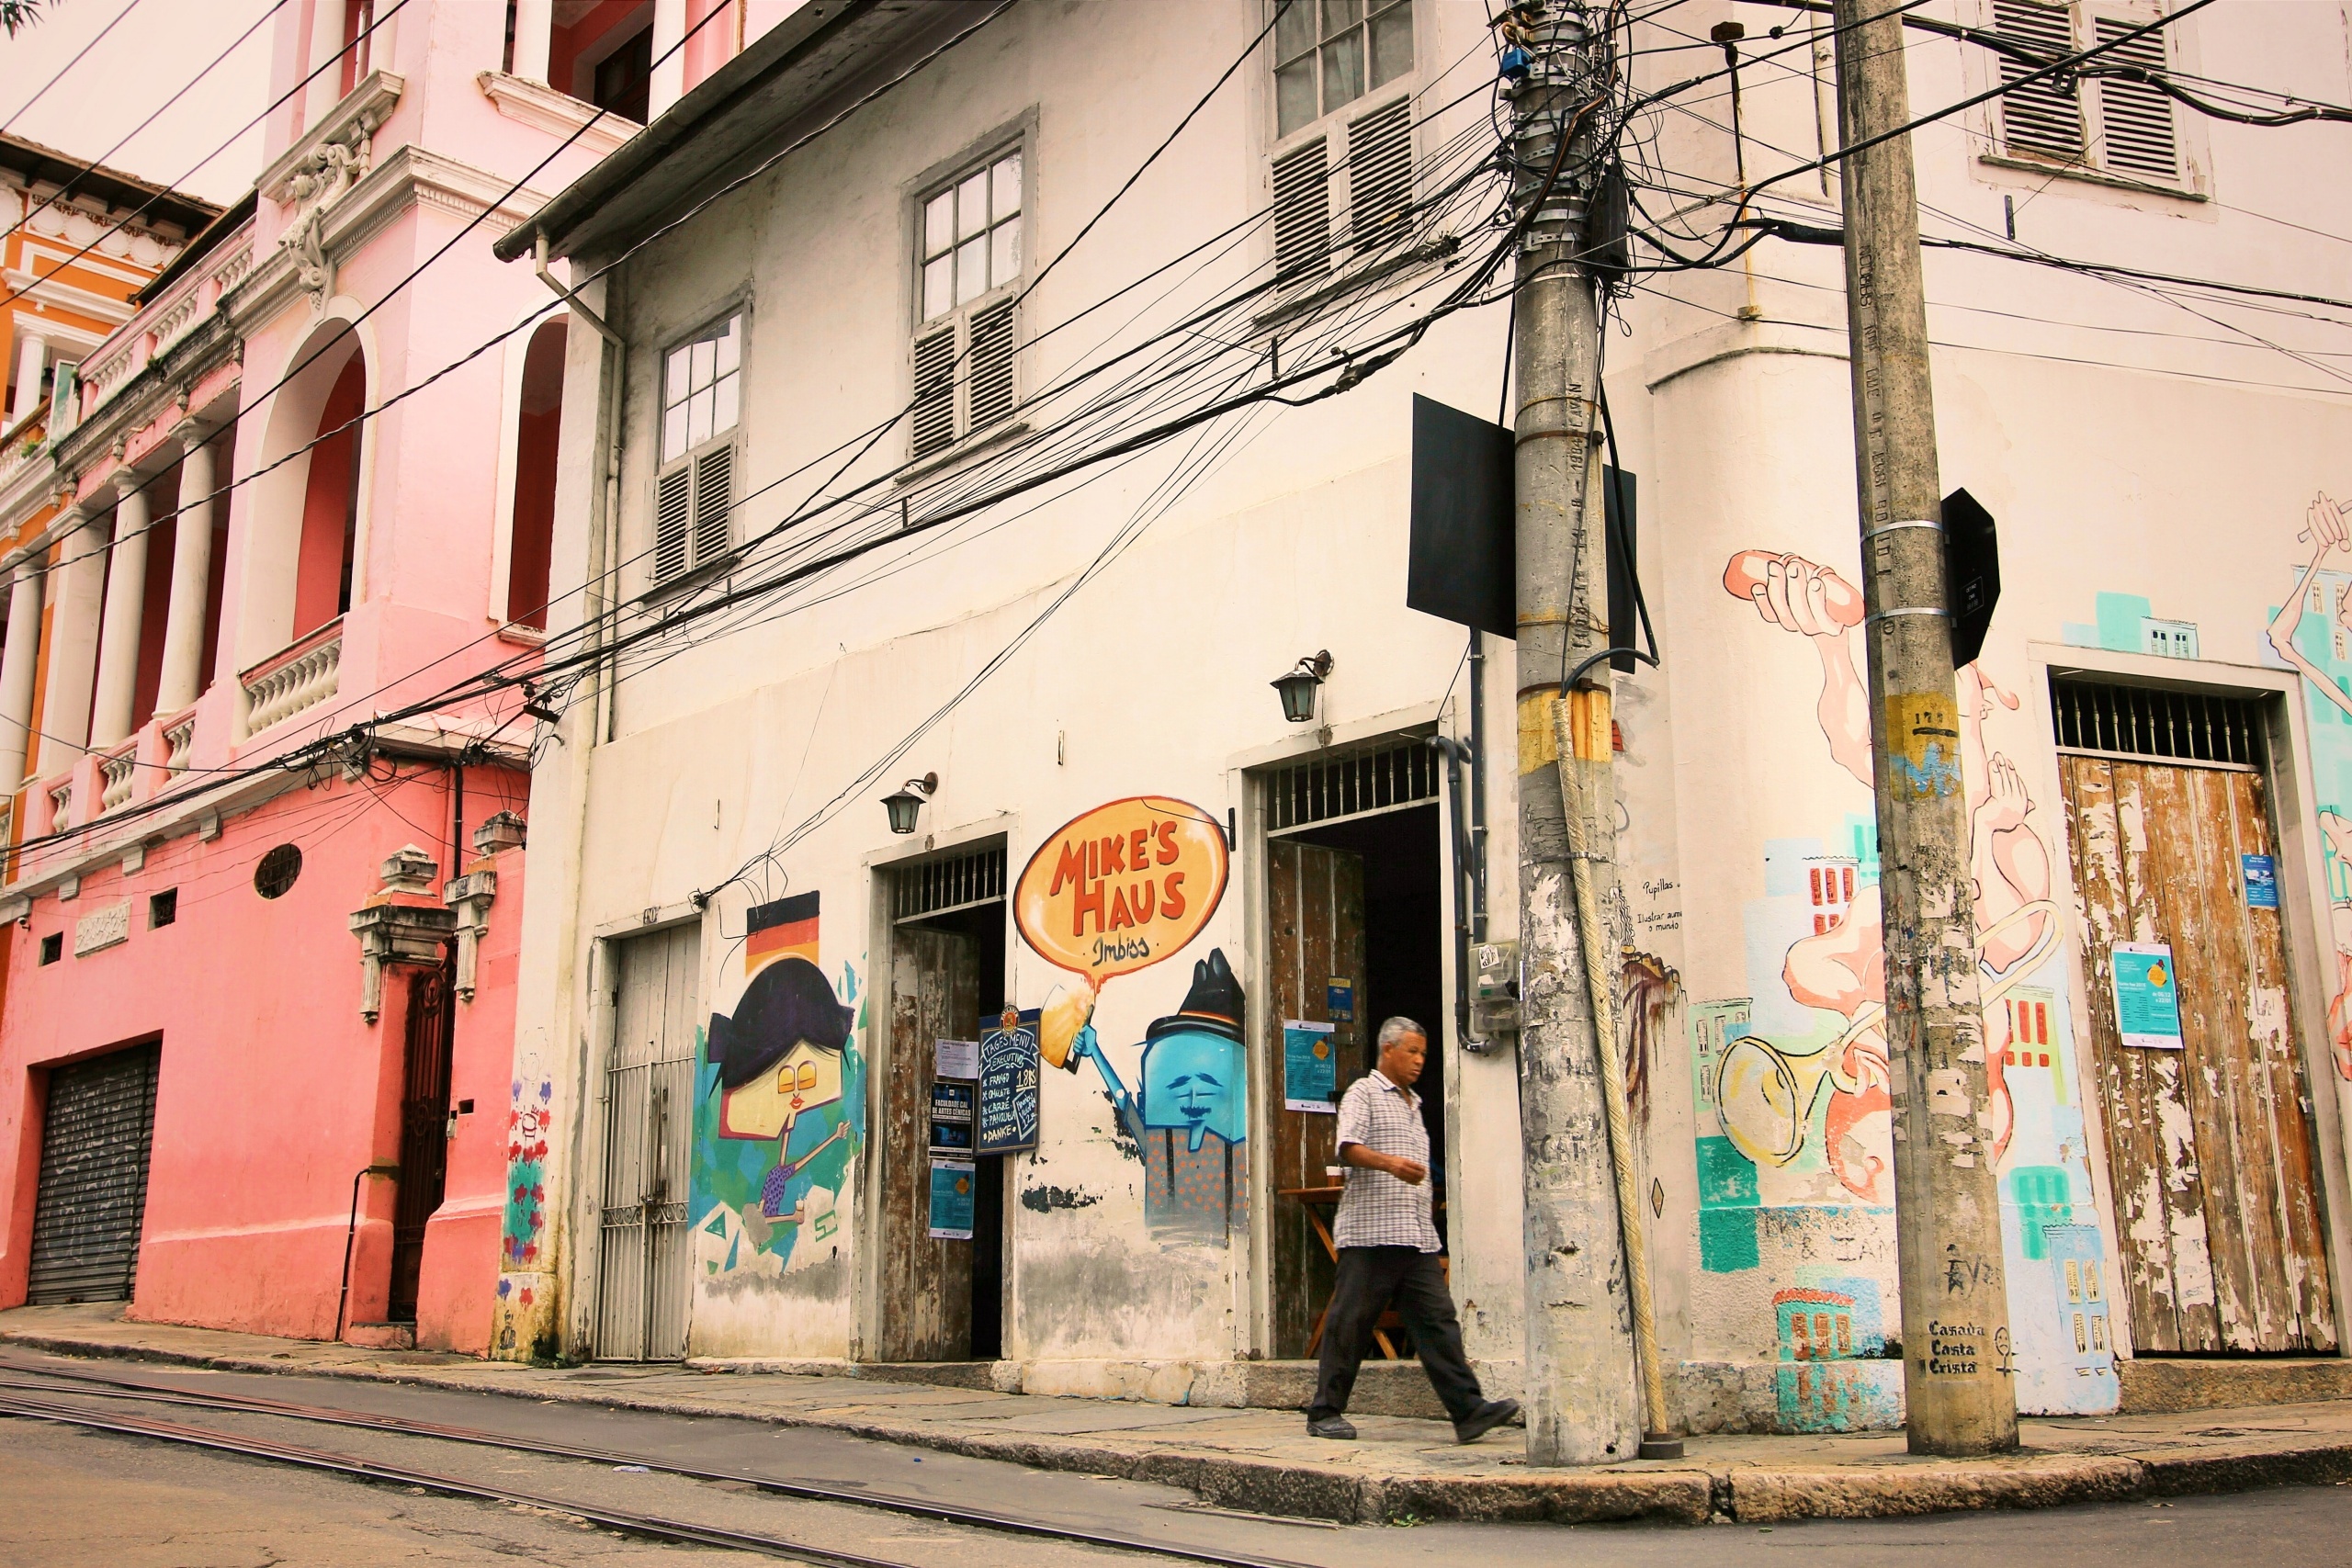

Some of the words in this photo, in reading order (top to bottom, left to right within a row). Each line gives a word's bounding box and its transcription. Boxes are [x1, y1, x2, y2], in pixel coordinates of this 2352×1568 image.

[1049, 819, 1180, 897] MIKE'S
[1643, 878, 1673, 900] Pupillas
[1073, 872, 1186, 937] HAUS
[1637, 911, 1665, 924] Ilustrar
[1092, 932, 1150, 966] Imbiss
[984, 1036, 1009, 1056] TAGES
[1010, 1033, 1030, 1048] MENU
[932, 1106, 938, 1114] DE
[988, 1124, 1012, 1143] DANKE
[1928, 1320, 1985, 1337] Casada
[1930, 1338, 1975, 1356] Casta
